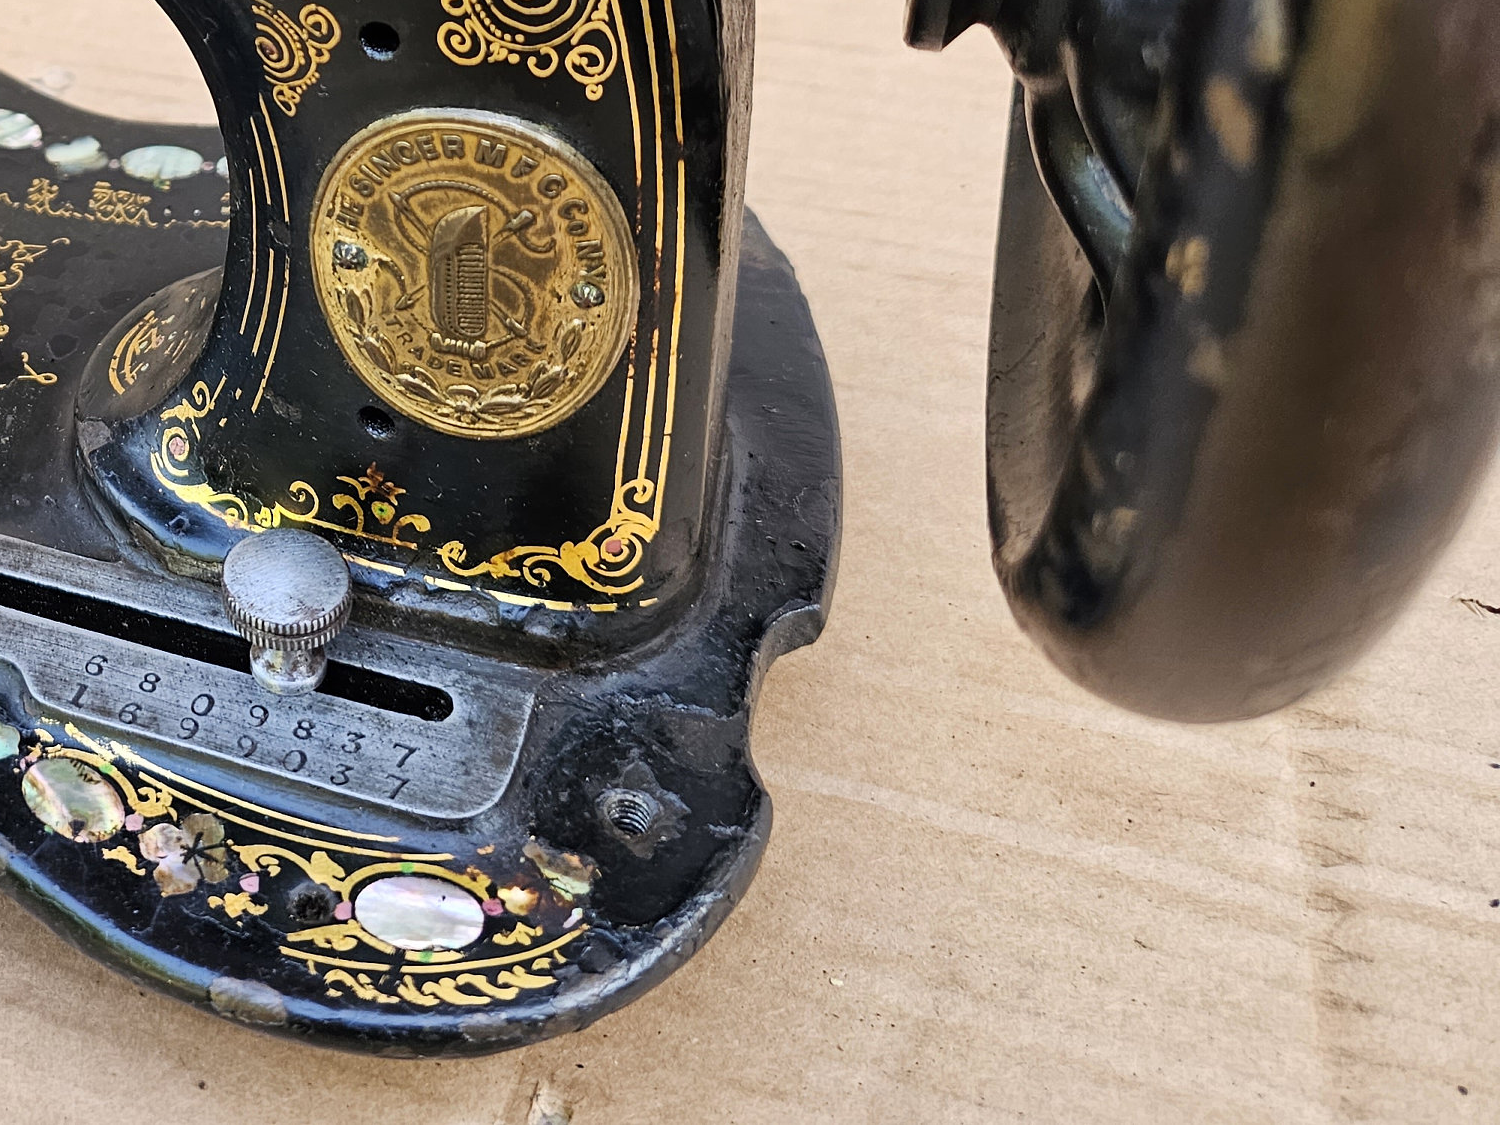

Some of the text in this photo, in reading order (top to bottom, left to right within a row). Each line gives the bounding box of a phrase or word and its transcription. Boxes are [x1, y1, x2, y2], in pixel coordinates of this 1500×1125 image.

[350, 134, 466, 197] SINGER
[474, 139, 567, 199] MFG
[386, 315, 547, 380] TRADE MARK
[68, 682, 410, 800] 1699037
[85, 654, 420, 768] 6809837
